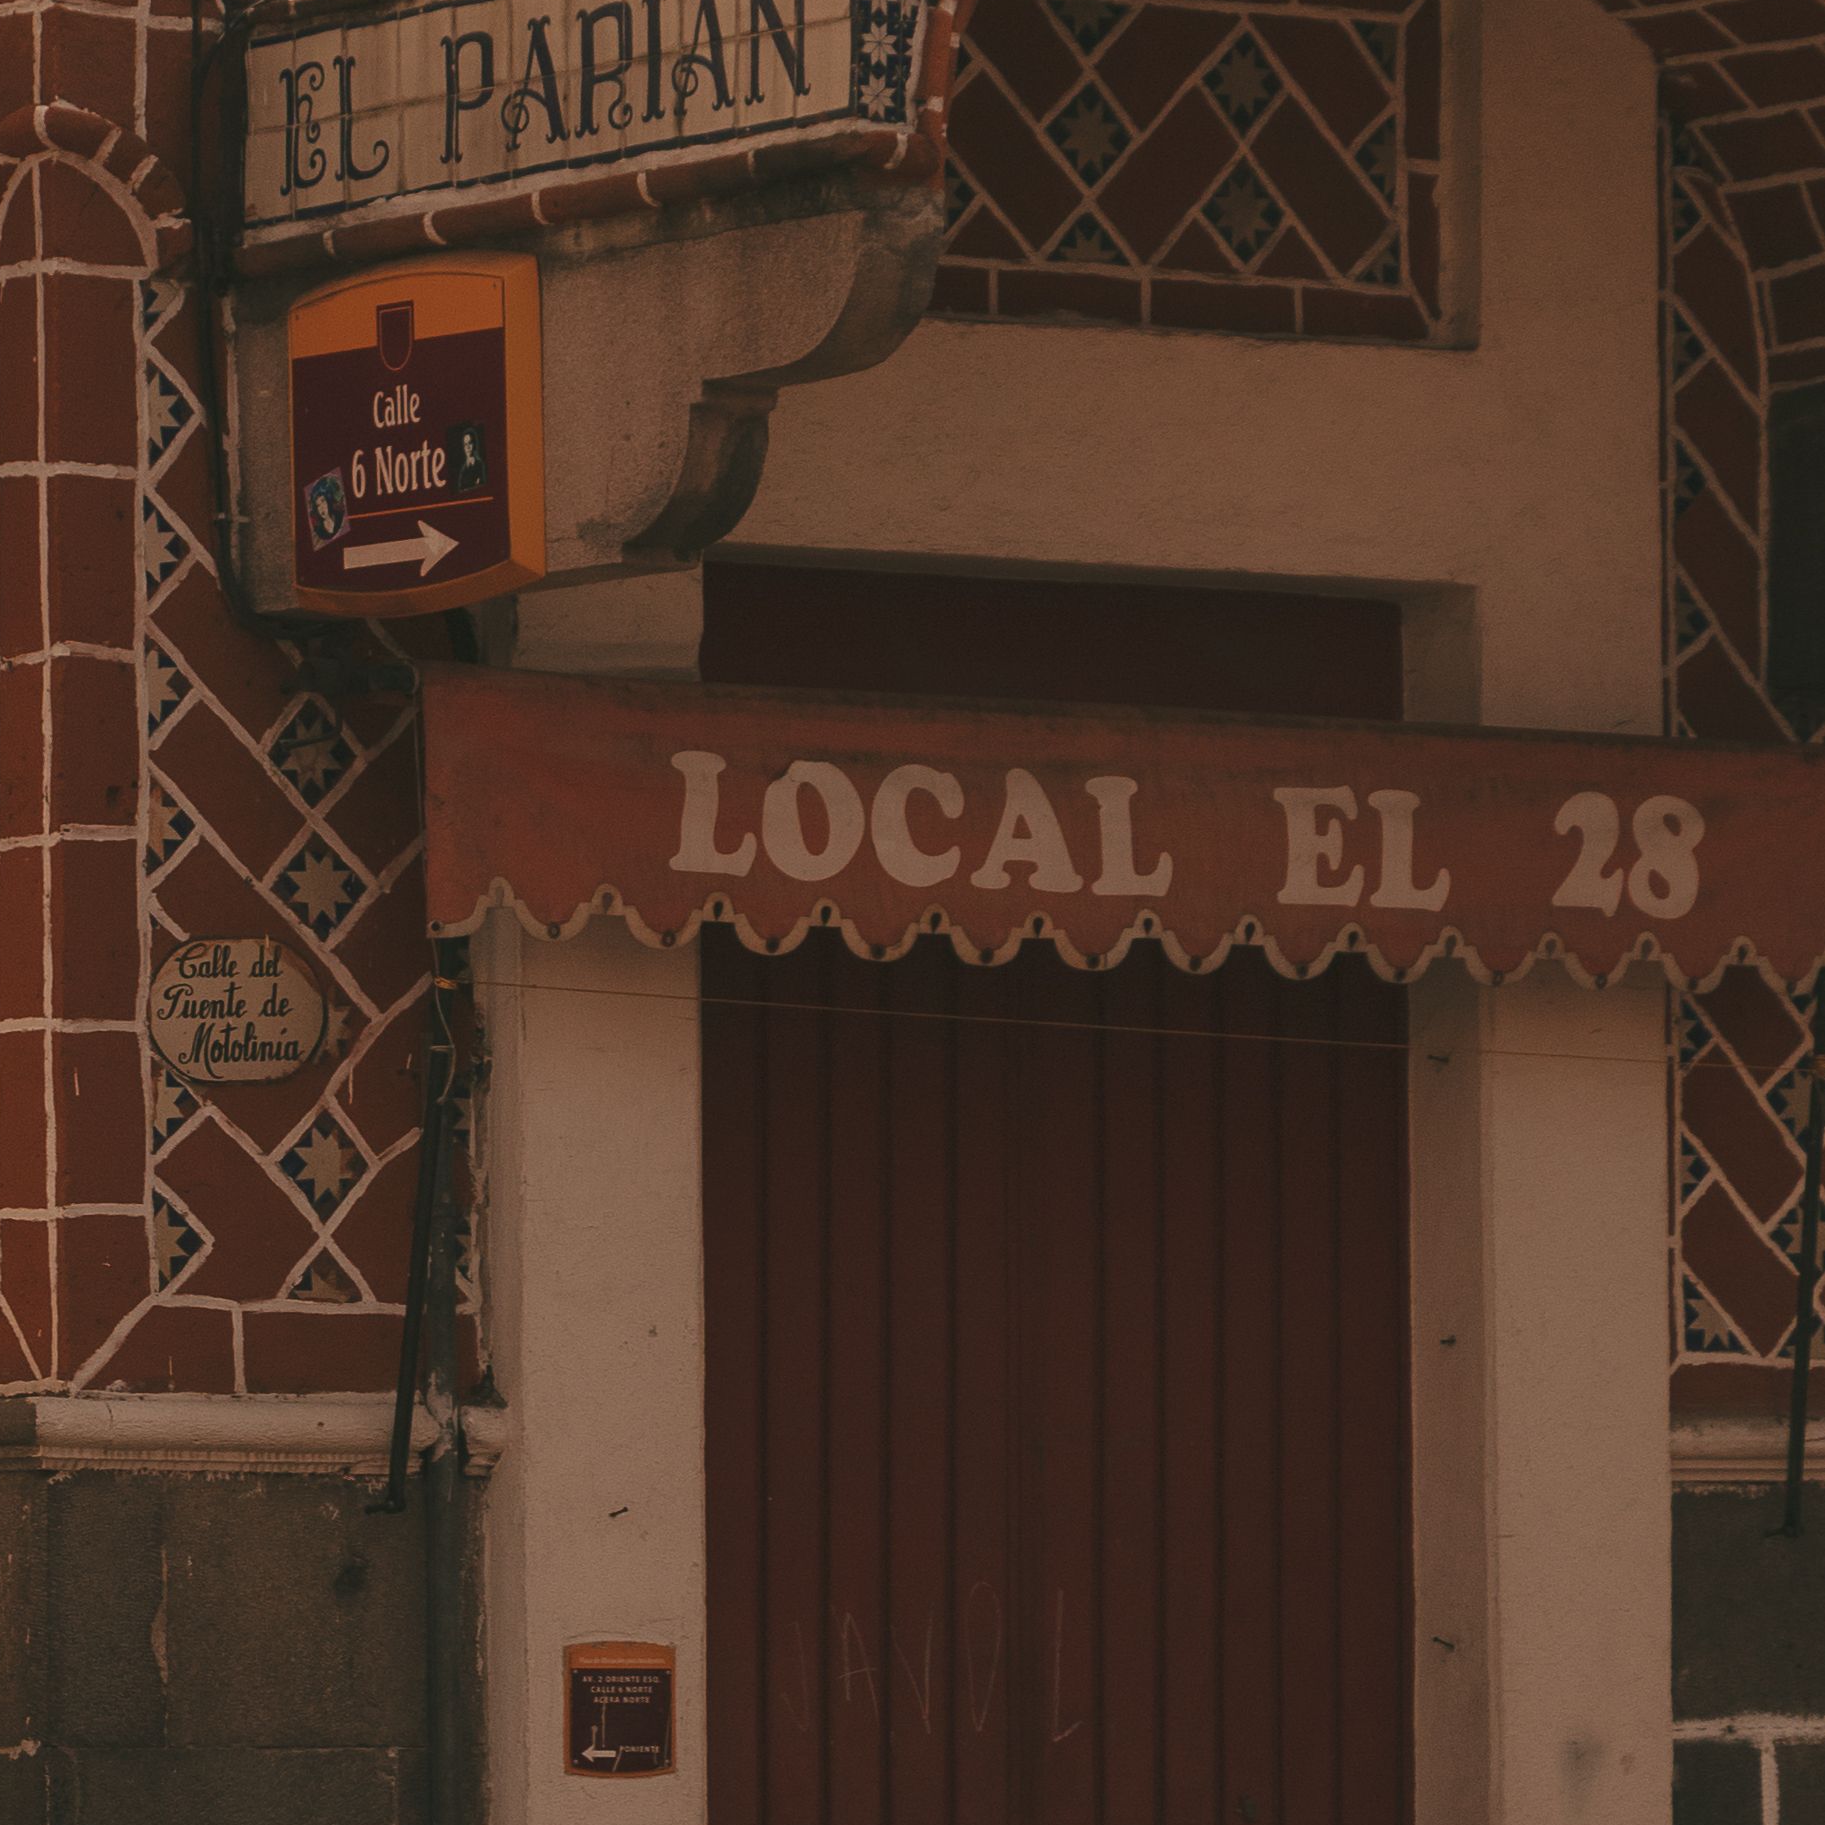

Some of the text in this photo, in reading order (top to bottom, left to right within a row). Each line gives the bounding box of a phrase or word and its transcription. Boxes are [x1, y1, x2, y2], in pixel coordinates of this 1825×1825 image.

[279, 54, 389, 196] EL
[372, 382, 421, 429] Calle
[350, 440, 448, 499] 6 Norte
[669, 748, 1707, 920] LOCAL EL 28
[176, 942, 283, 979] Calle del
[157, 982, 293, 1020] Puente de
